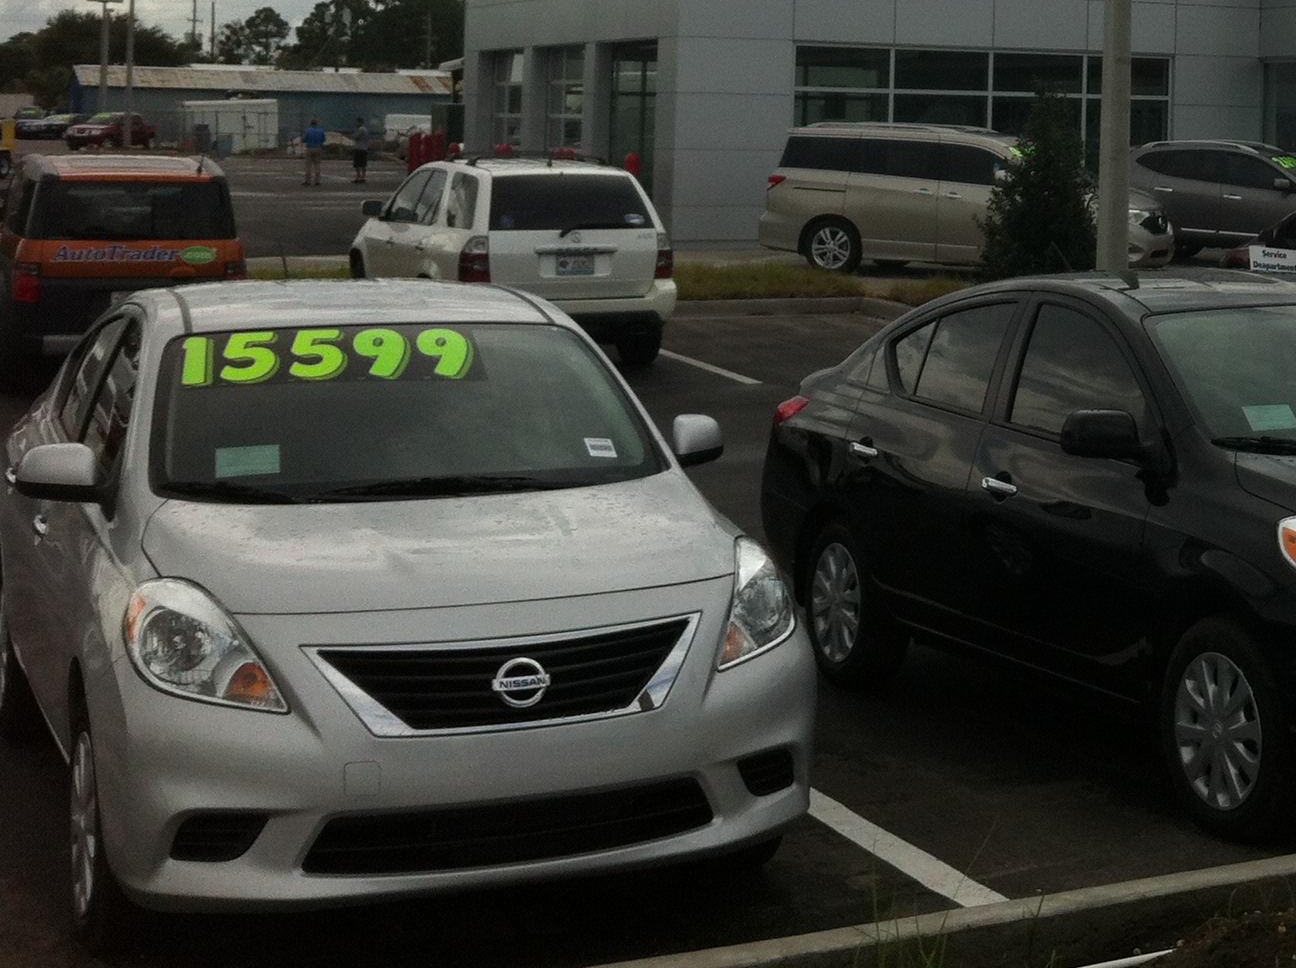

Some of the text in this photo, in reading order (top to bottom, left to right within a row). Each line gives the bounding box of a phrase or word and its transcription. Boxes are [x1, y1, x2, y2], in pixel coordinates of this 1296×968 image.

[1262, 249, 1287, 260] Service
[181, 328, 474, 386] 15599
[499, 675, 547, 689] NISSAN
